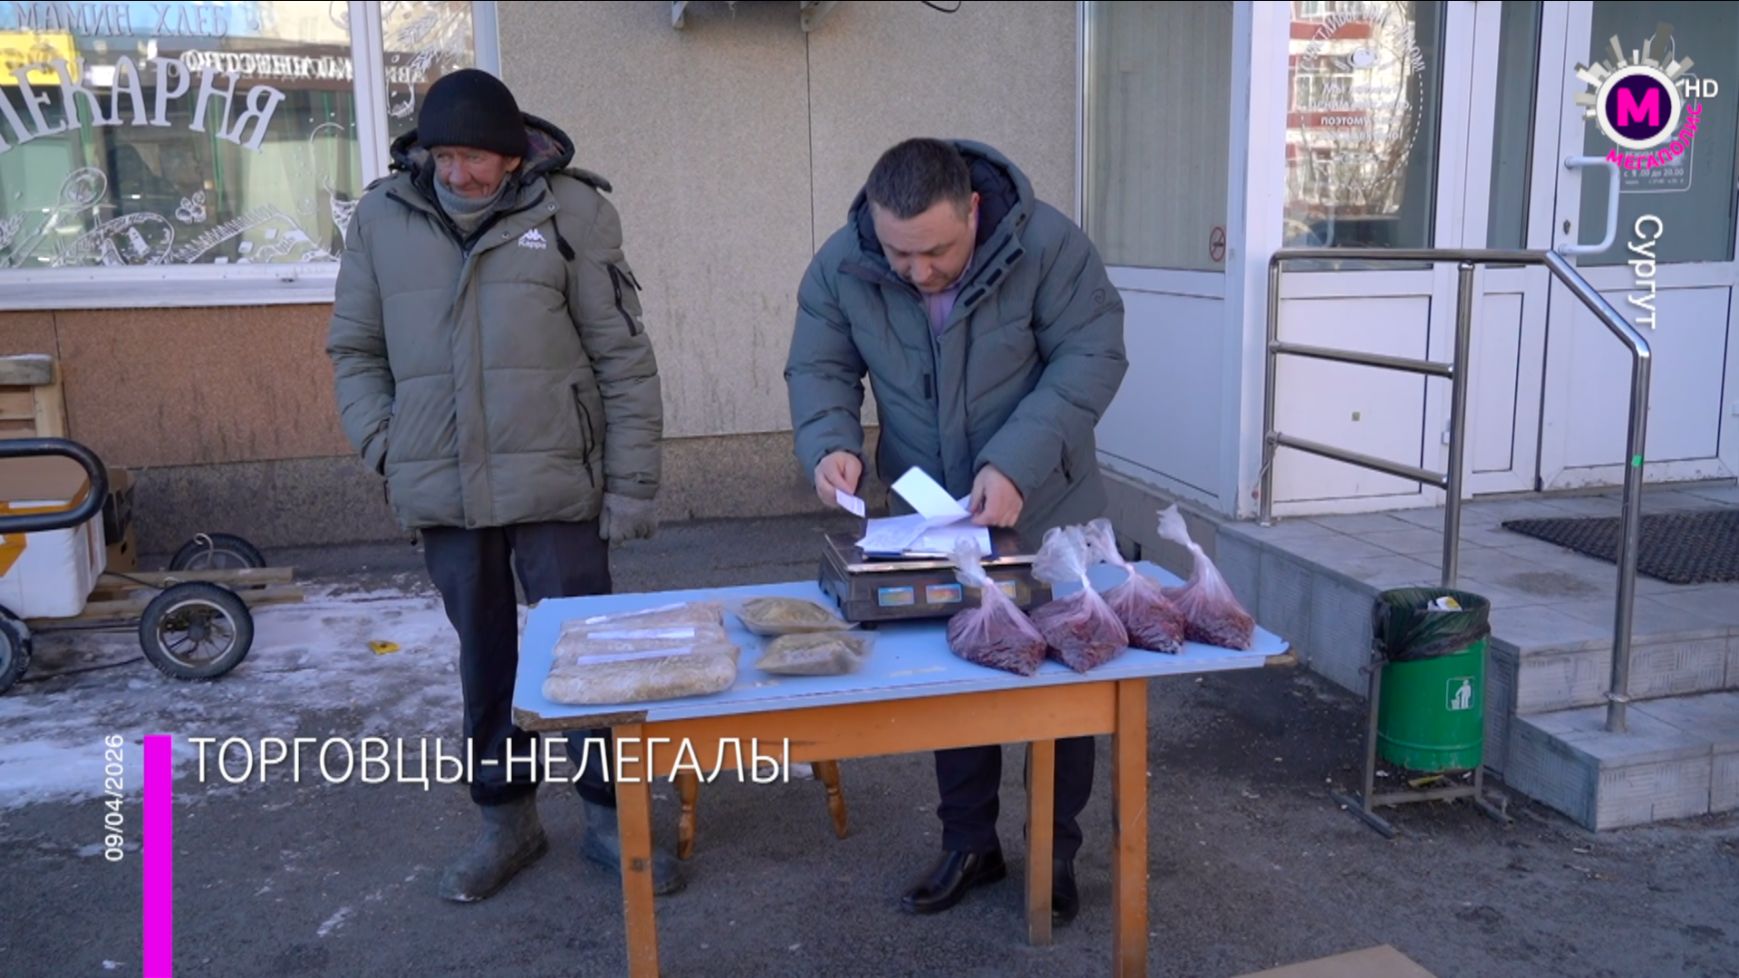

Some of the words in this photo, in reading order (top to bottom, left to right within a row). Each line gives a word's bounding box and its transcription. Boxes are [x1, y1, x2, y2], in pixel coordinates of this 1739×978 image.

[15, 3, 135, 37] МАМИН
[150, 3, 229, 38] ХЛЕБ
[1321, 115, 1371, 127] поэтому
